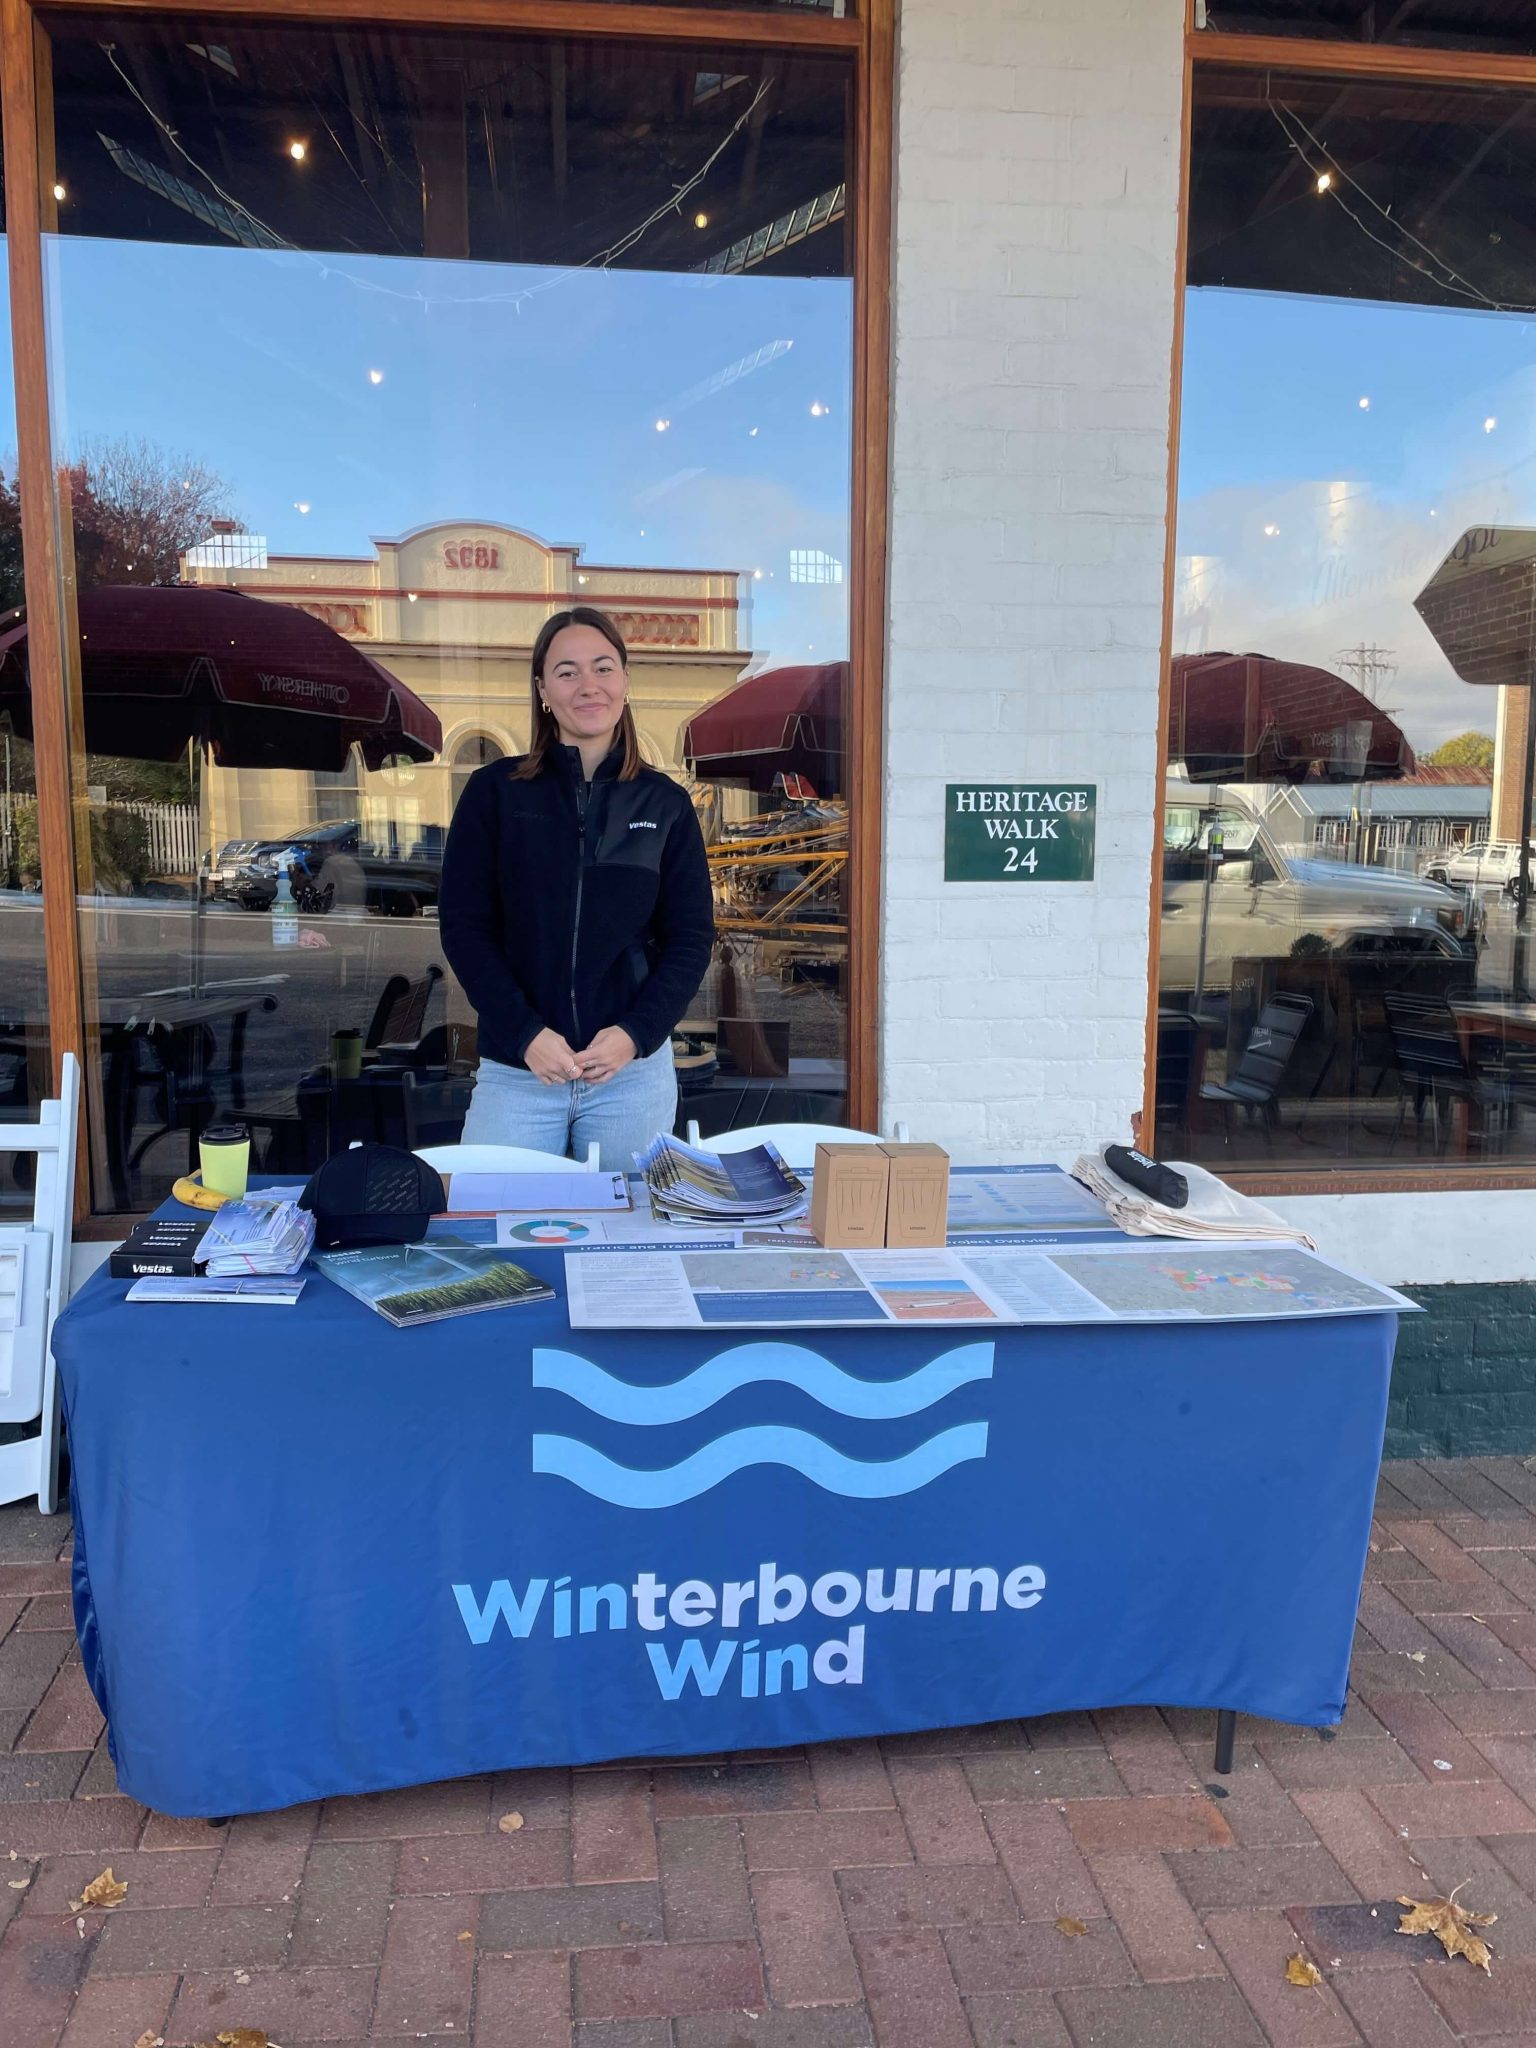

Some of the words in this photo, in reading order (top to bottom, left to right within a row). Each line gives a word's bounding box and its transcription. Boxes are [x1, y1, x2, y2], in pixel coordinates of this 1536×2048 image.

[956, 791, 1089, 812] HERITAGE
[629, 820, 657, 830] Vestas
[983, 819, 1060, 839] WALK
[1003, 846, 1039, 874] 24
[132, 1263, 174, 1274] Vestas
[452, 1563, 1046, 1645] Winterbourne
[645, 1624, 866, 1701] Wind
